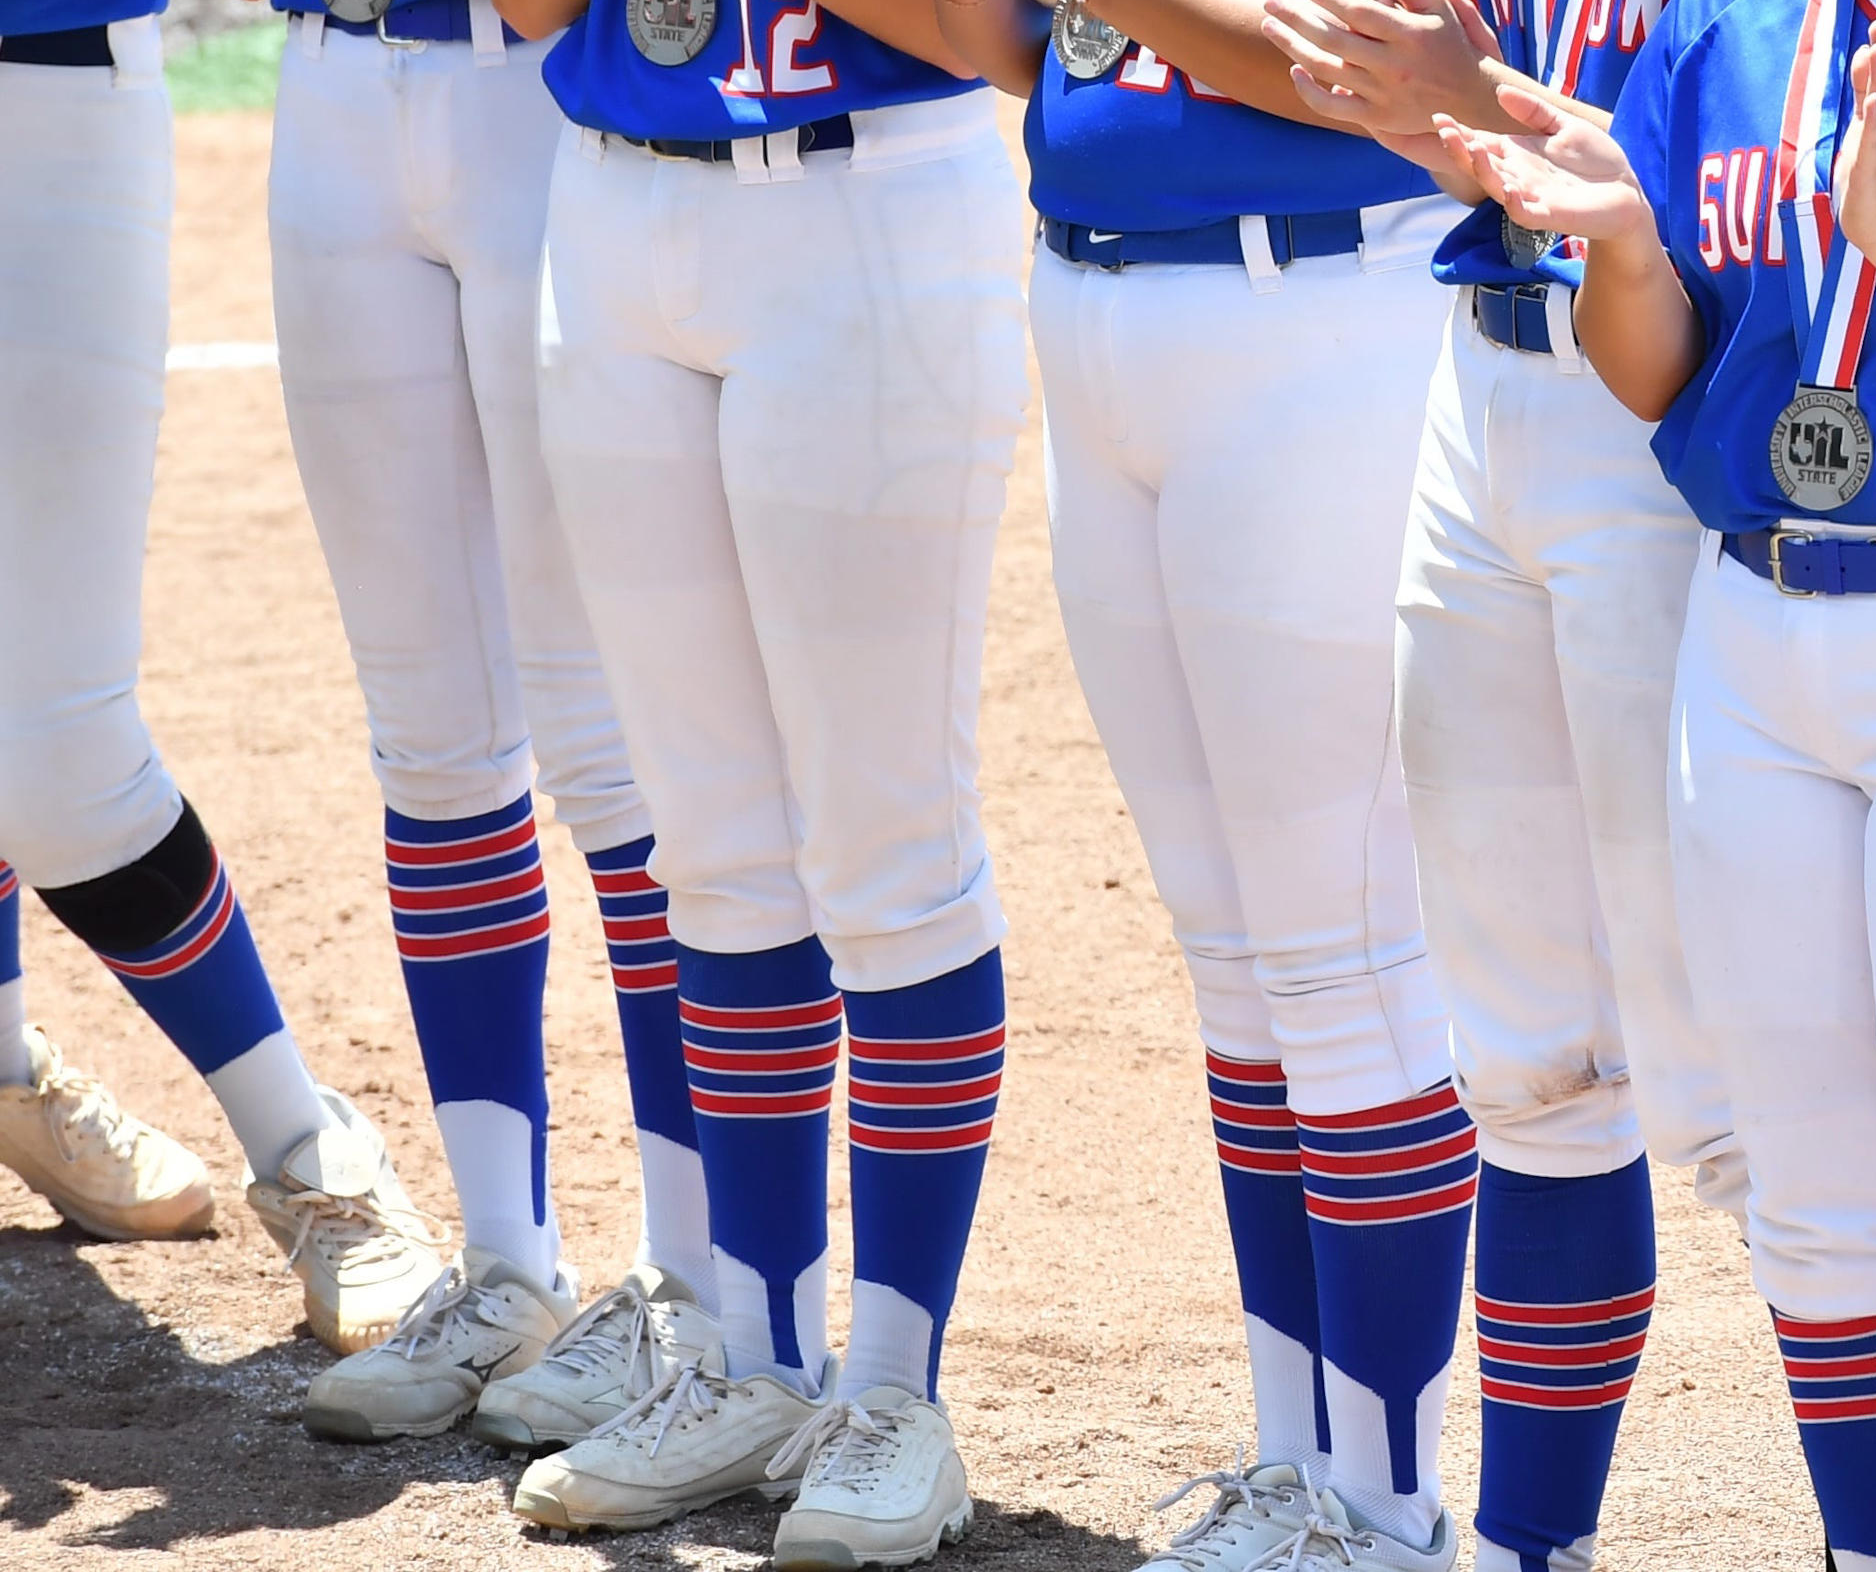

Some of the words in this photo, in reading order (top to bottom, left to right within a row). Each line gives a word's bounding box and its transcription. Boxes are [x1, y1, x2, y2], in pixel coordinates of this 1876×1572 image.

[650, 28, 685, 43] STATE
[1788, 422, 1849, 469] UIL
[1797, 470, 1836, 485] STATE
